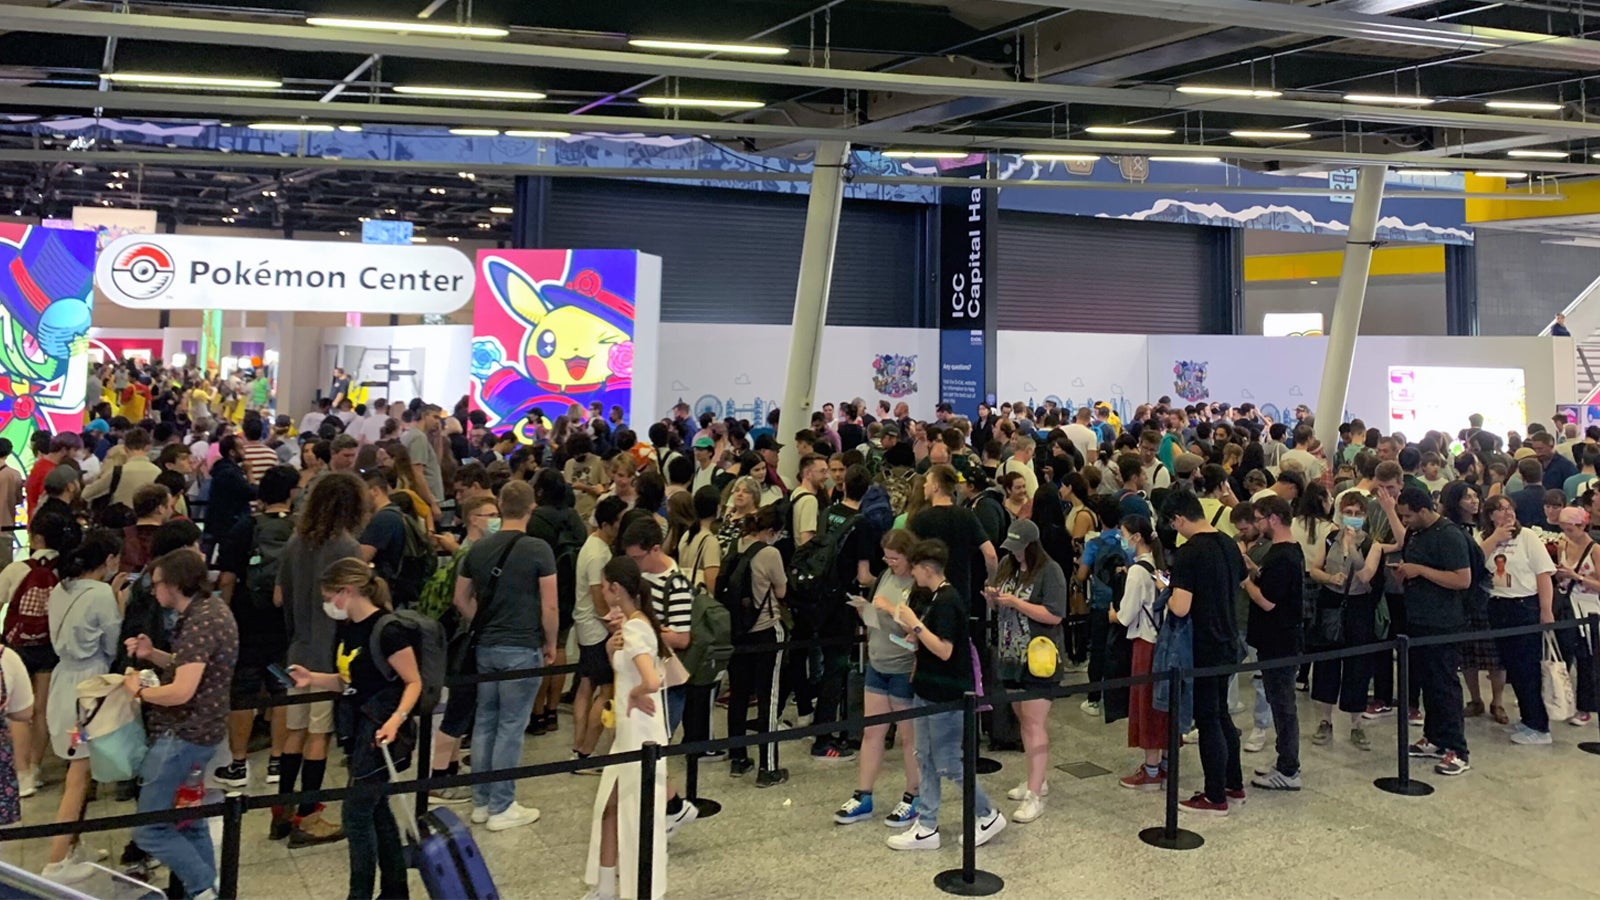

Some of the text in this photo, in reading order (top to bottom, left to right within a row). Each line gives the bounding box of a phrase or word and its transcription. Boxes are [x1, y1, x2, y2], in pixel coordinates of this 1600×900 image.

[189, 260, 464, 292] Pokémon Center
[951, 272, 965, 318] ICC
[967, 230, 983, 319] Capital
